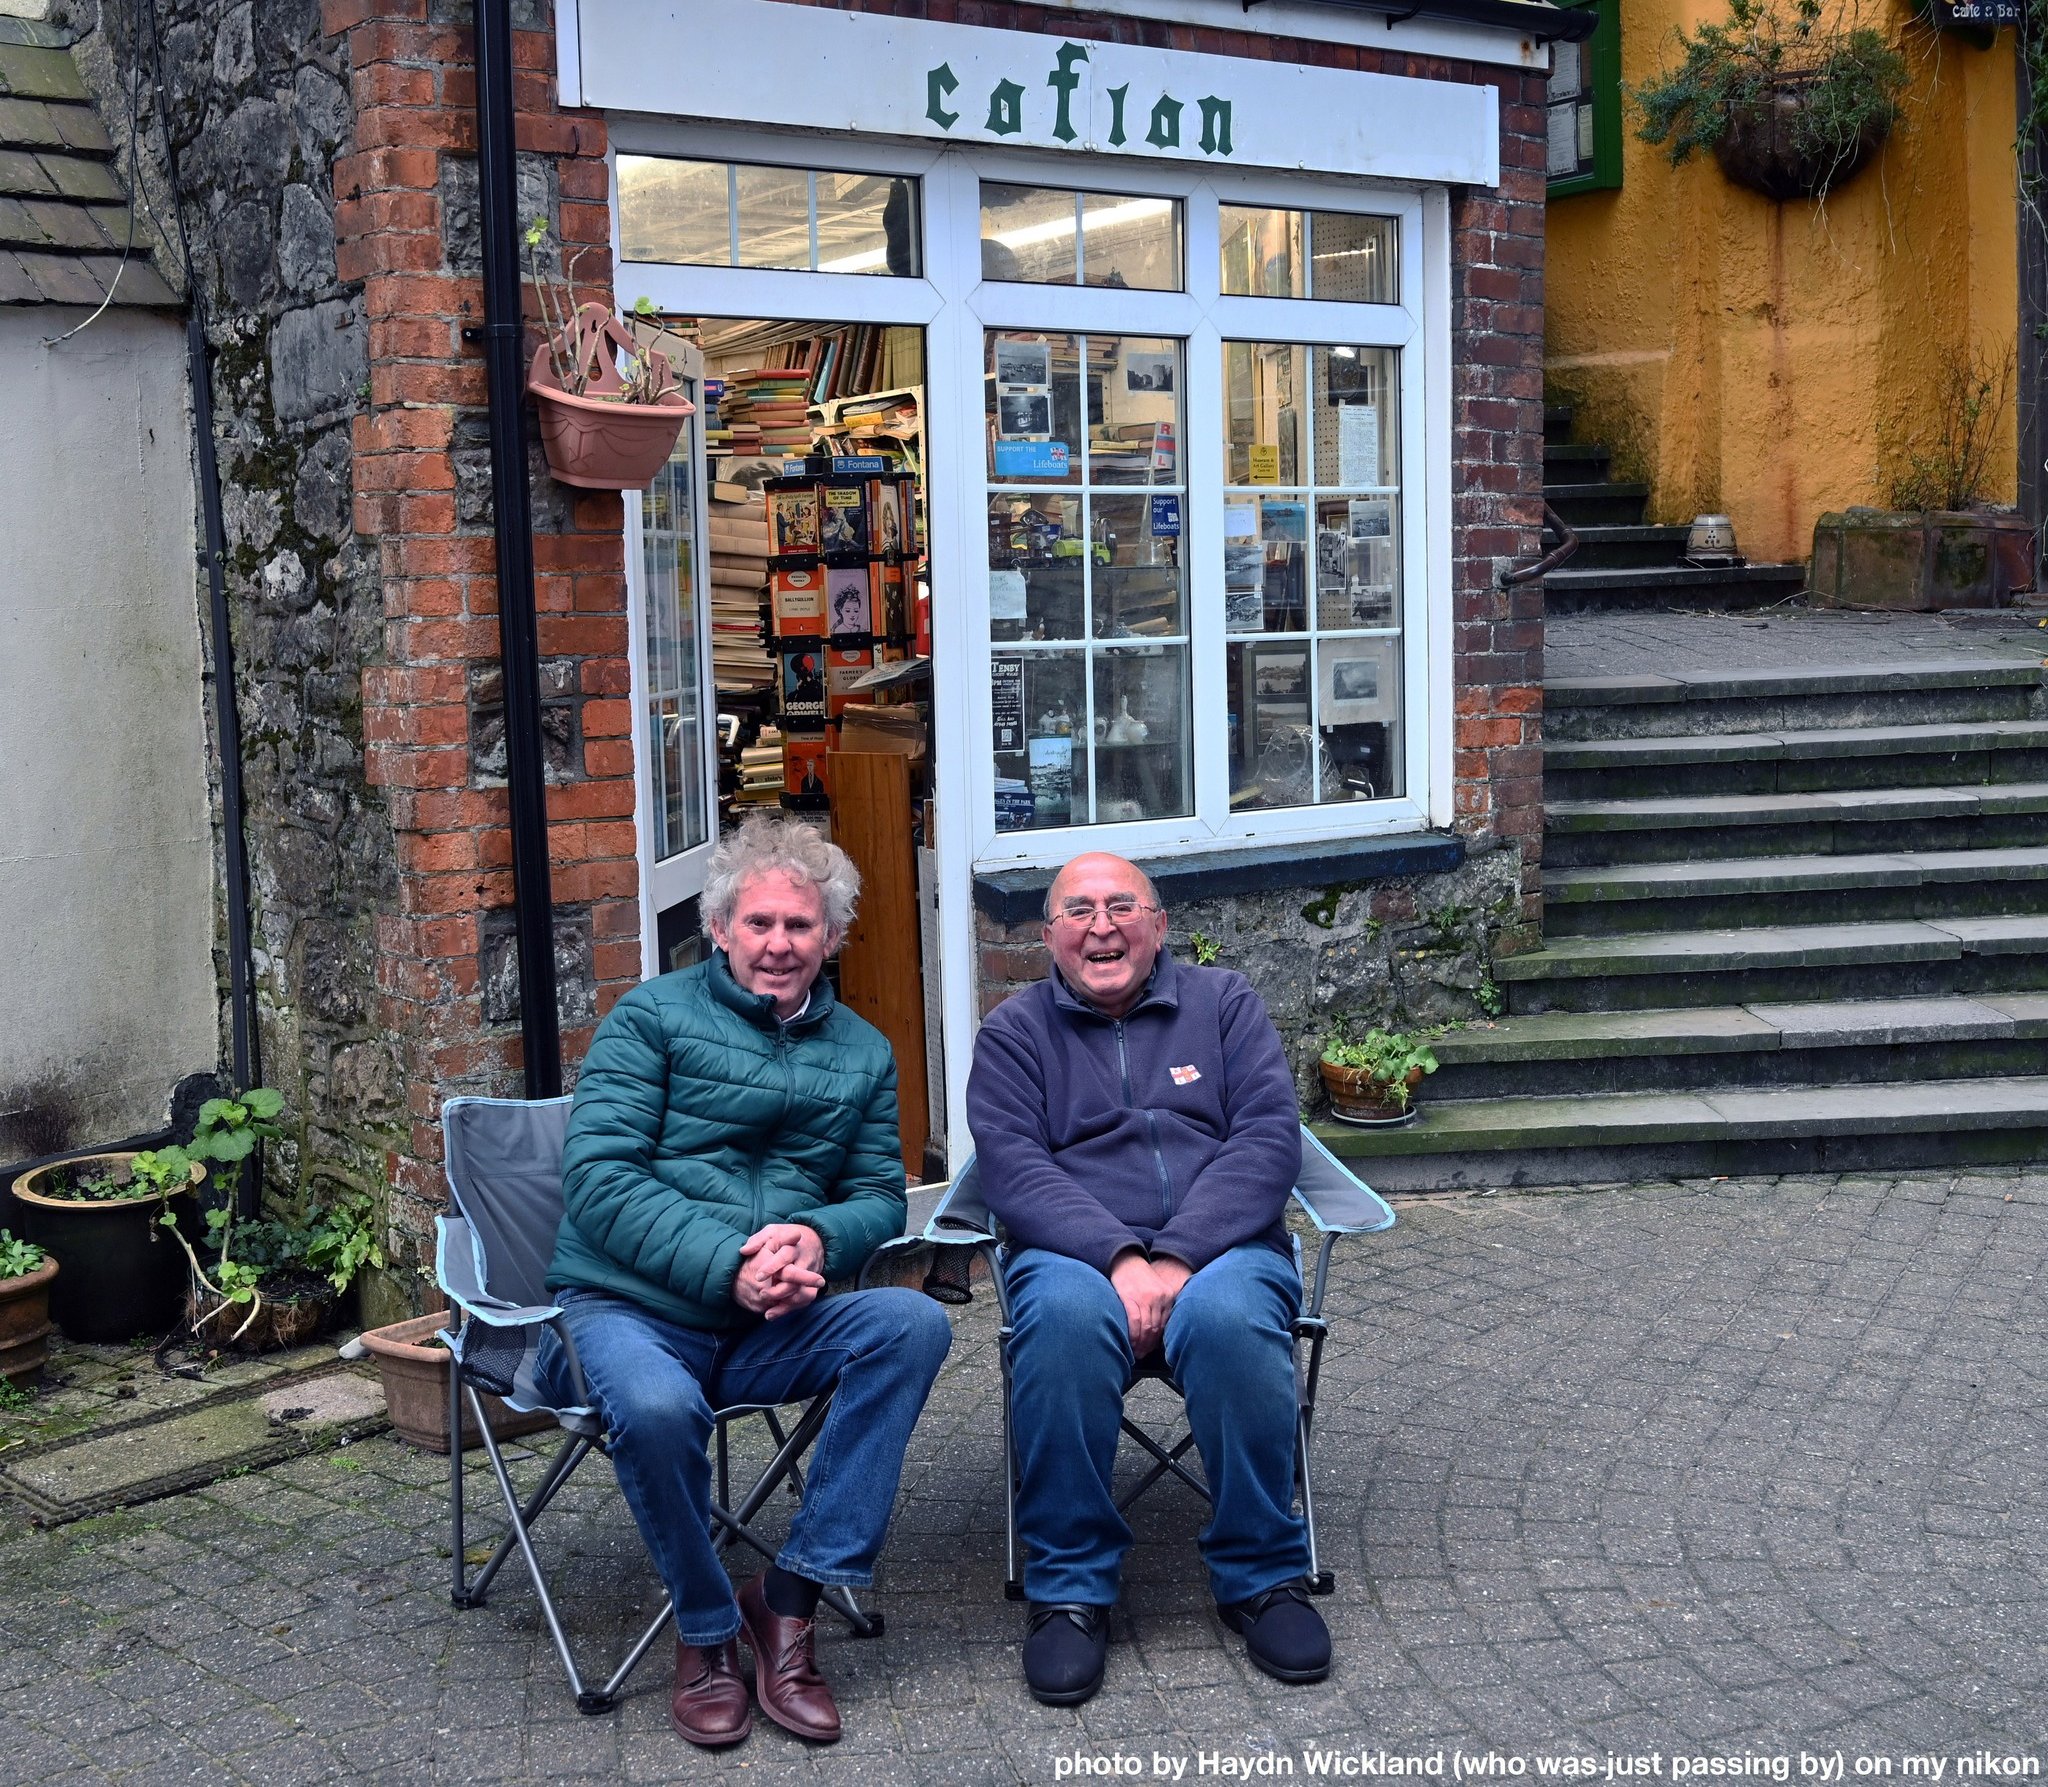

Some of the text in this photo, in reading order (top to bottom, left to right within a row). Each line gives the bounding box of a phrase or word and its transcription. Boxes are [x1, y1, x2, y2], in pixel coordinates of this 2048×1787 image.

[1997, 3, 2021, 18] Bar
[926, 41, 1233, 157] cofion
[996, 445, 1024, 453] SUPPORT
[788, 463, 805, 473] Fontana
[848, 460, 880, 469] Fontana
[1033, 459, 1068, 469] Lifeboats
[1152, 497, 1176, 506] Support
[1152, 522, 1180, 530] Lifeboats
[991, 661, 1020, 673] TENBY
[786, 701, 824, 711] GEORGE
